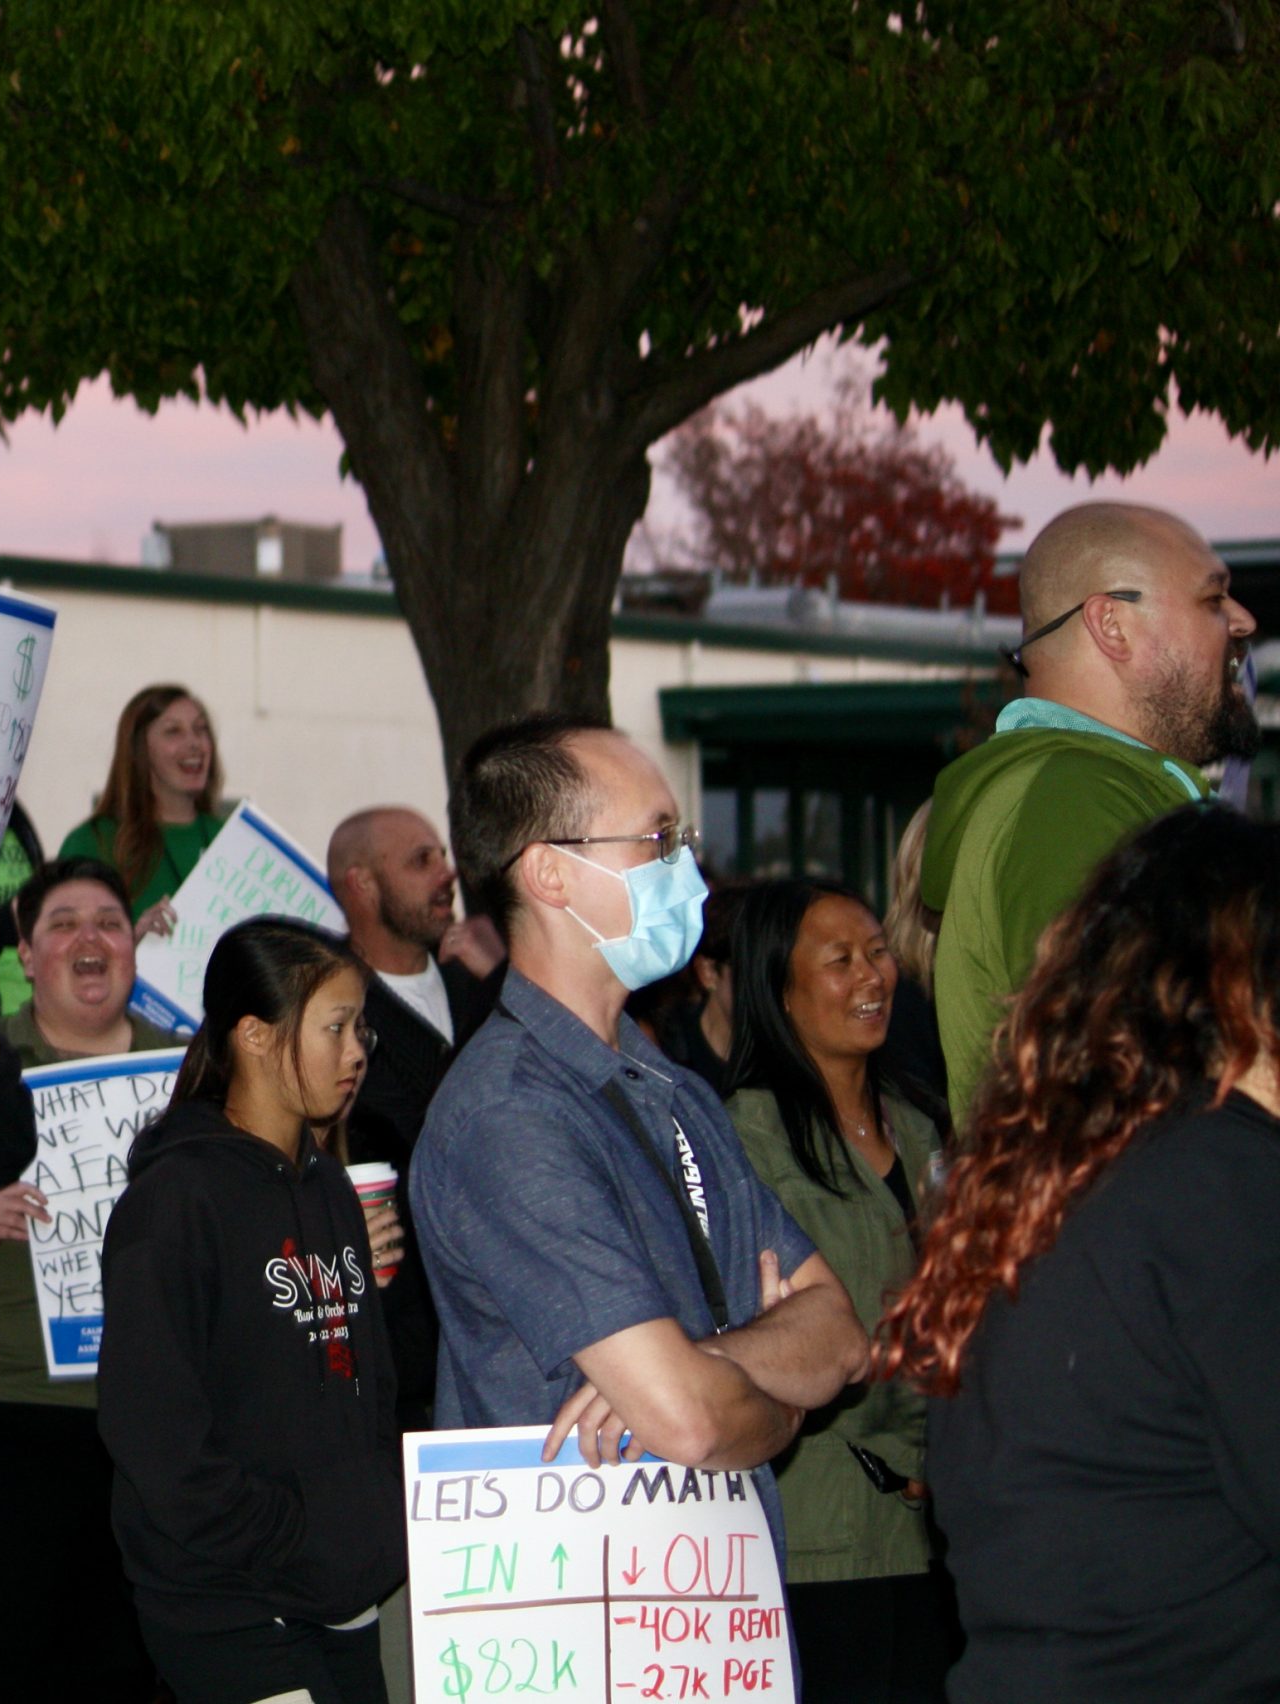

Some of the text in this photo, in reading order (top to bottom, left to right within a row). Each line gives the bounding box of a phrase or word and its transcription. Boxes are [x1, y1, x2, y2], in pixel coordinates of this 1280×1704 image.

[411, 1466, 747, 1522] LET'S DO MATH
[442, 1542, 519, 1599] IN
[663, 1533, 759, 1600] OUT
[729, 1607, 785, 1643] RENT
[724, 1658, 775, 1697] PGE
